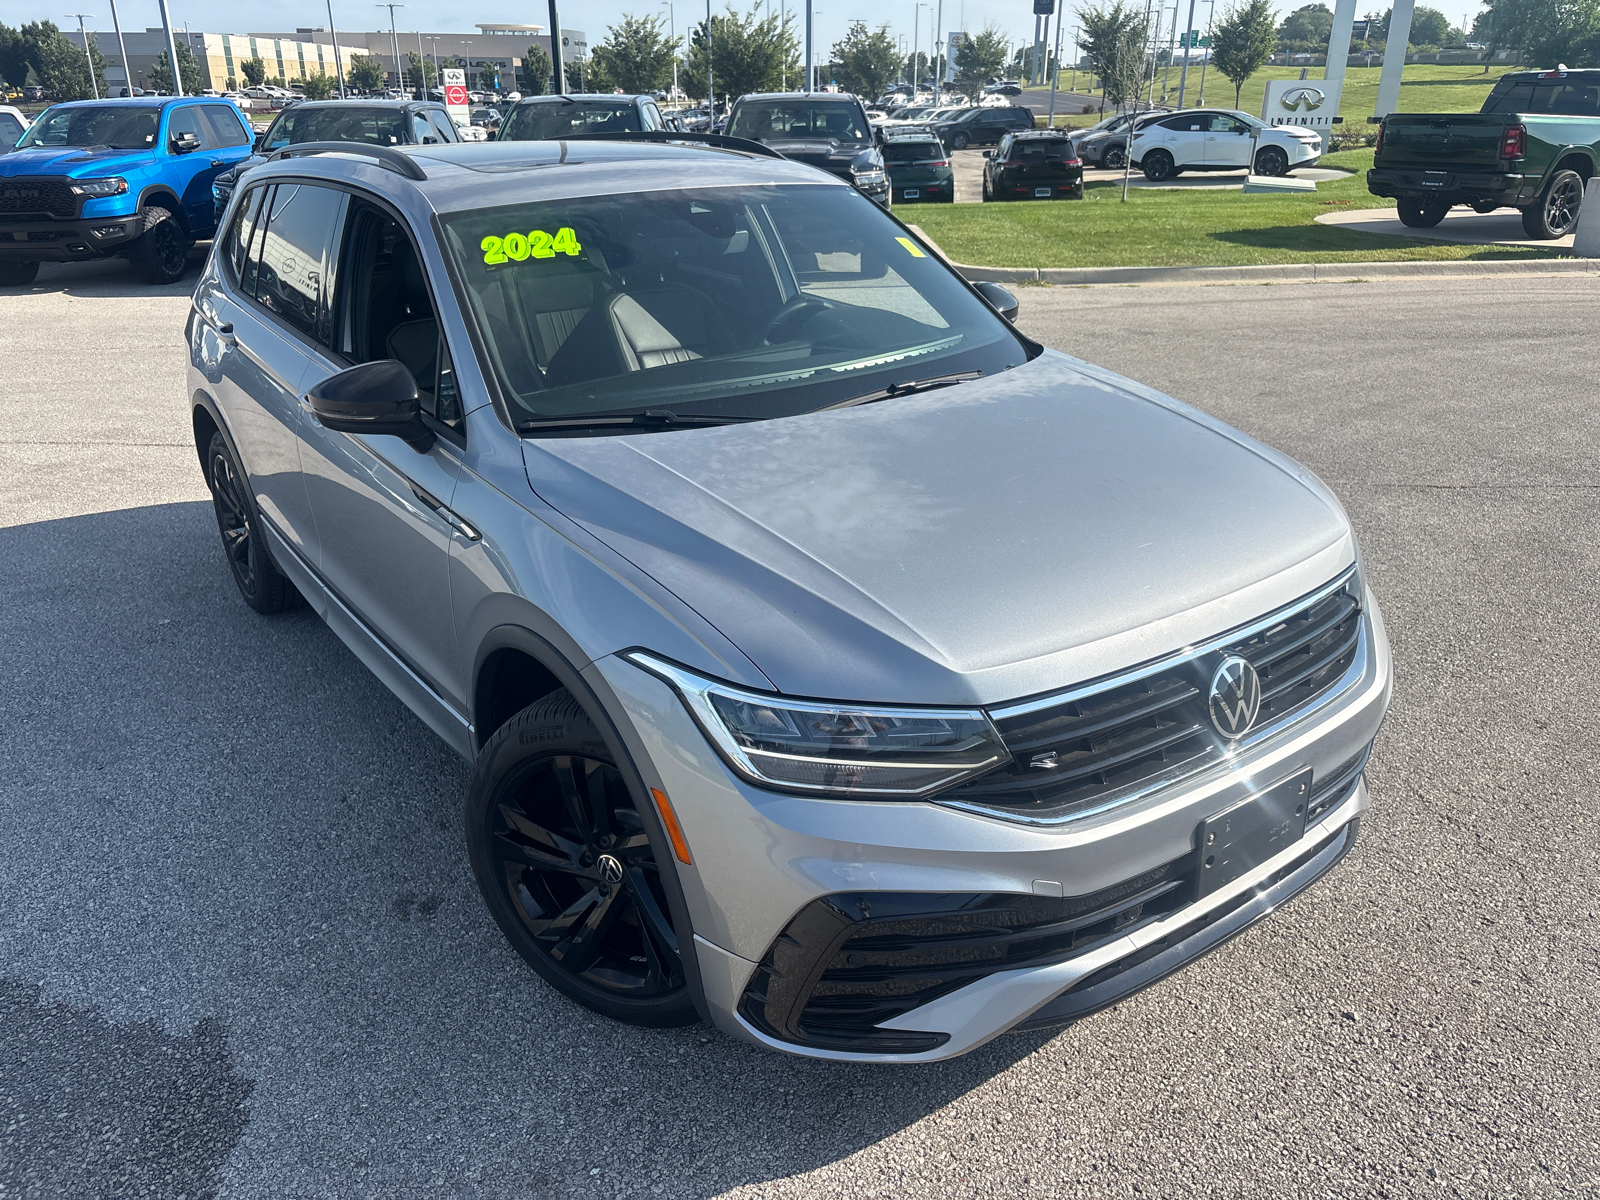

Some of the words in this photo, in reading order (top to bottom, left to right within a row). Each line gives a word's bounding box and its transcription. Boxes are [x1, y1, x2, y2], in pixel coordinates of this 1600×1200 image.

[1271, 117, 1328, 126] INFINITI
[0, 189, 40, 198] AM
[480, 227, 581, 265] 2024
[519, 725, 564, 745] PIRELLI
